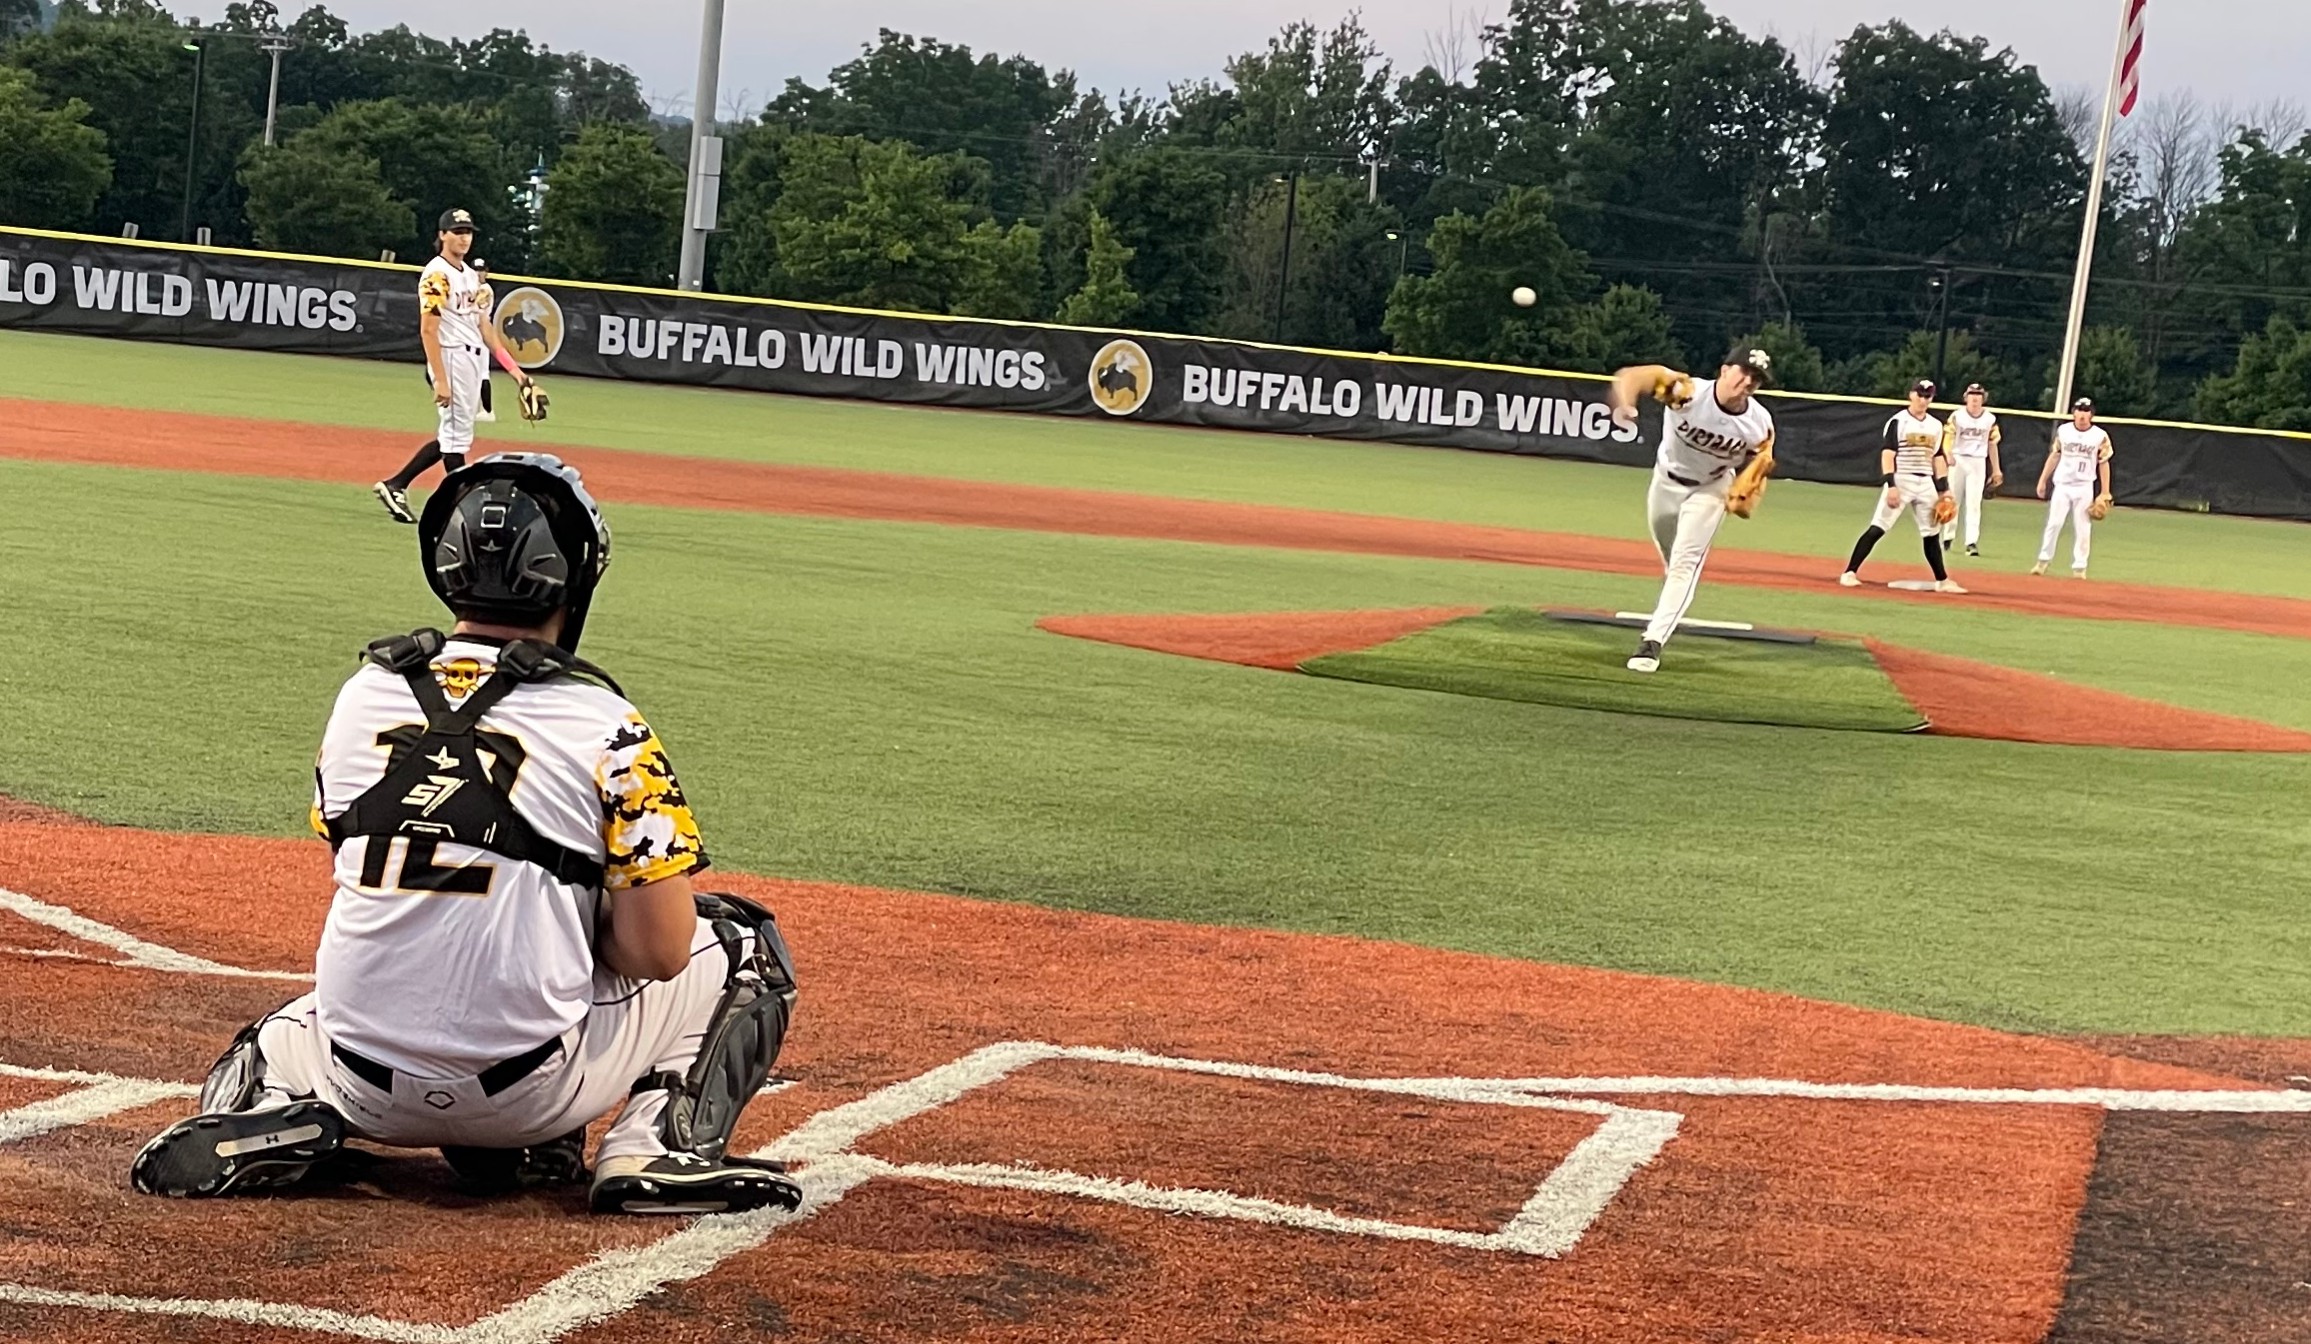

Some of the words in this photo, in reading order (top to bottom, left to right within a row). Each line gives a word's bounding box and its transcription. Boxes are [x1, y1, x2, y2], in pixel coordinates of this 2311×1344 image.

[72, 265, 193, 317] WILD
[205, 278, 357, 332] WINGS
[598, 314, 786, 370] BUFFALO
[800, 331, 903, 379] WILD
[915, 343, 1046, 391] WINGS
[1183, 364, 1361, 417] BUFFALO
[1376, 383, 1483, 427] WILD
[1496, 393, 1639, 443] WINGS
